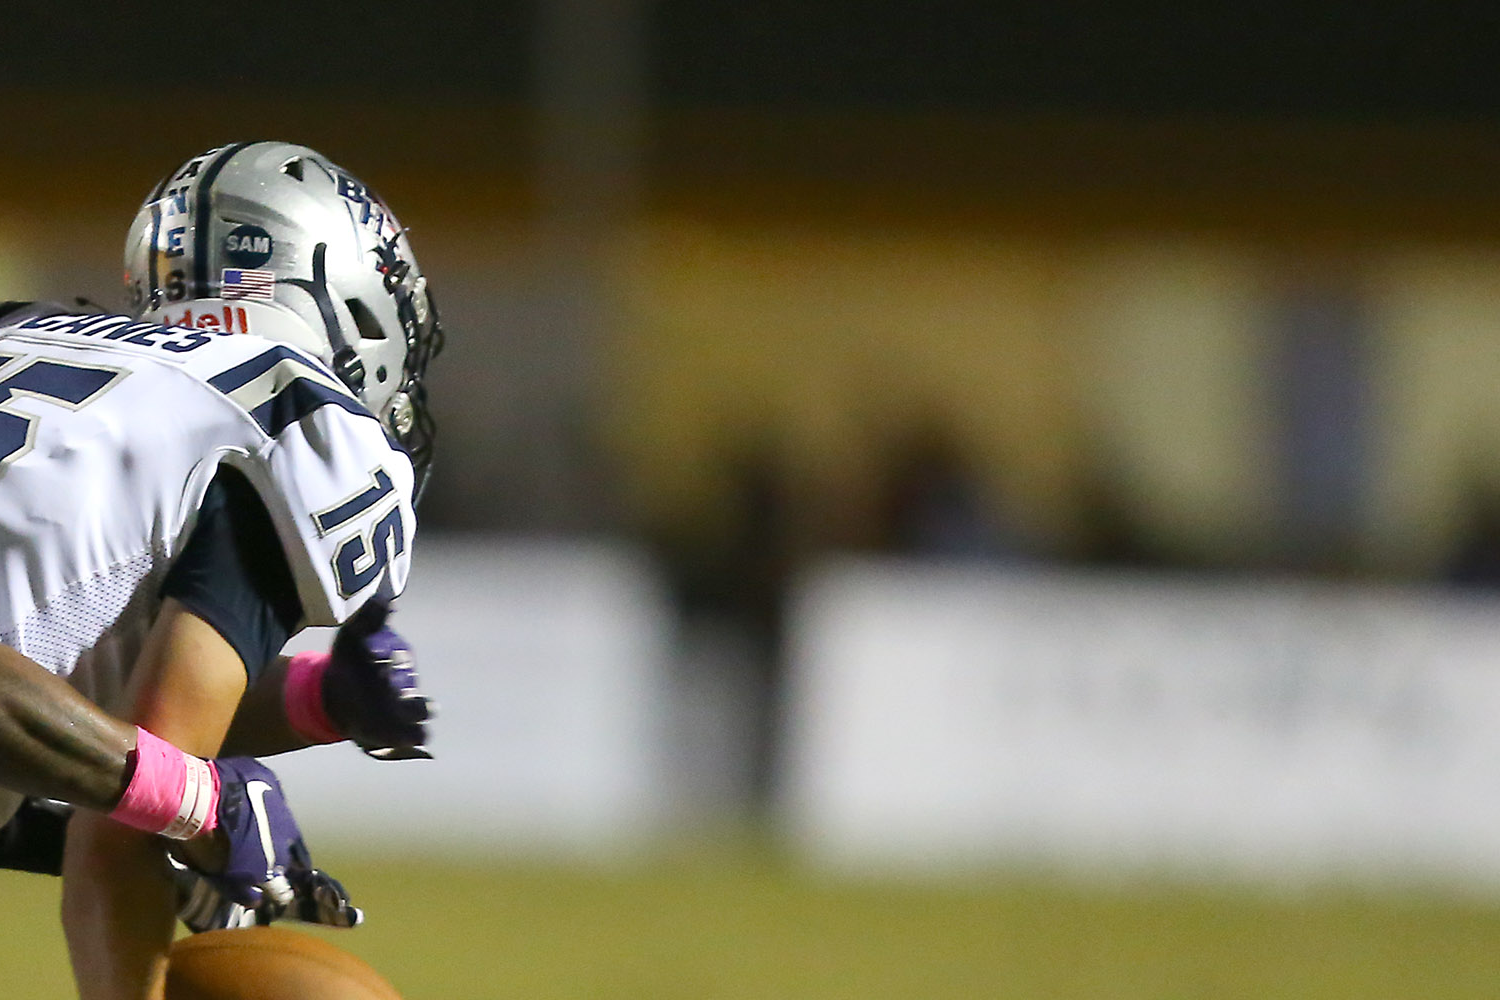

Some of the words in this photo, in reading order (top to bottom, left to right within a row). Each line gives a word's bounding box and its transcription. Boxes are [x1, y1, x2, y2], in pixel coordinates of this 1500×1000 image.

[226, 234, 270, 254] SAM
[163, 306, 249, 334] dell
[309, 464, 406, 601] 15
